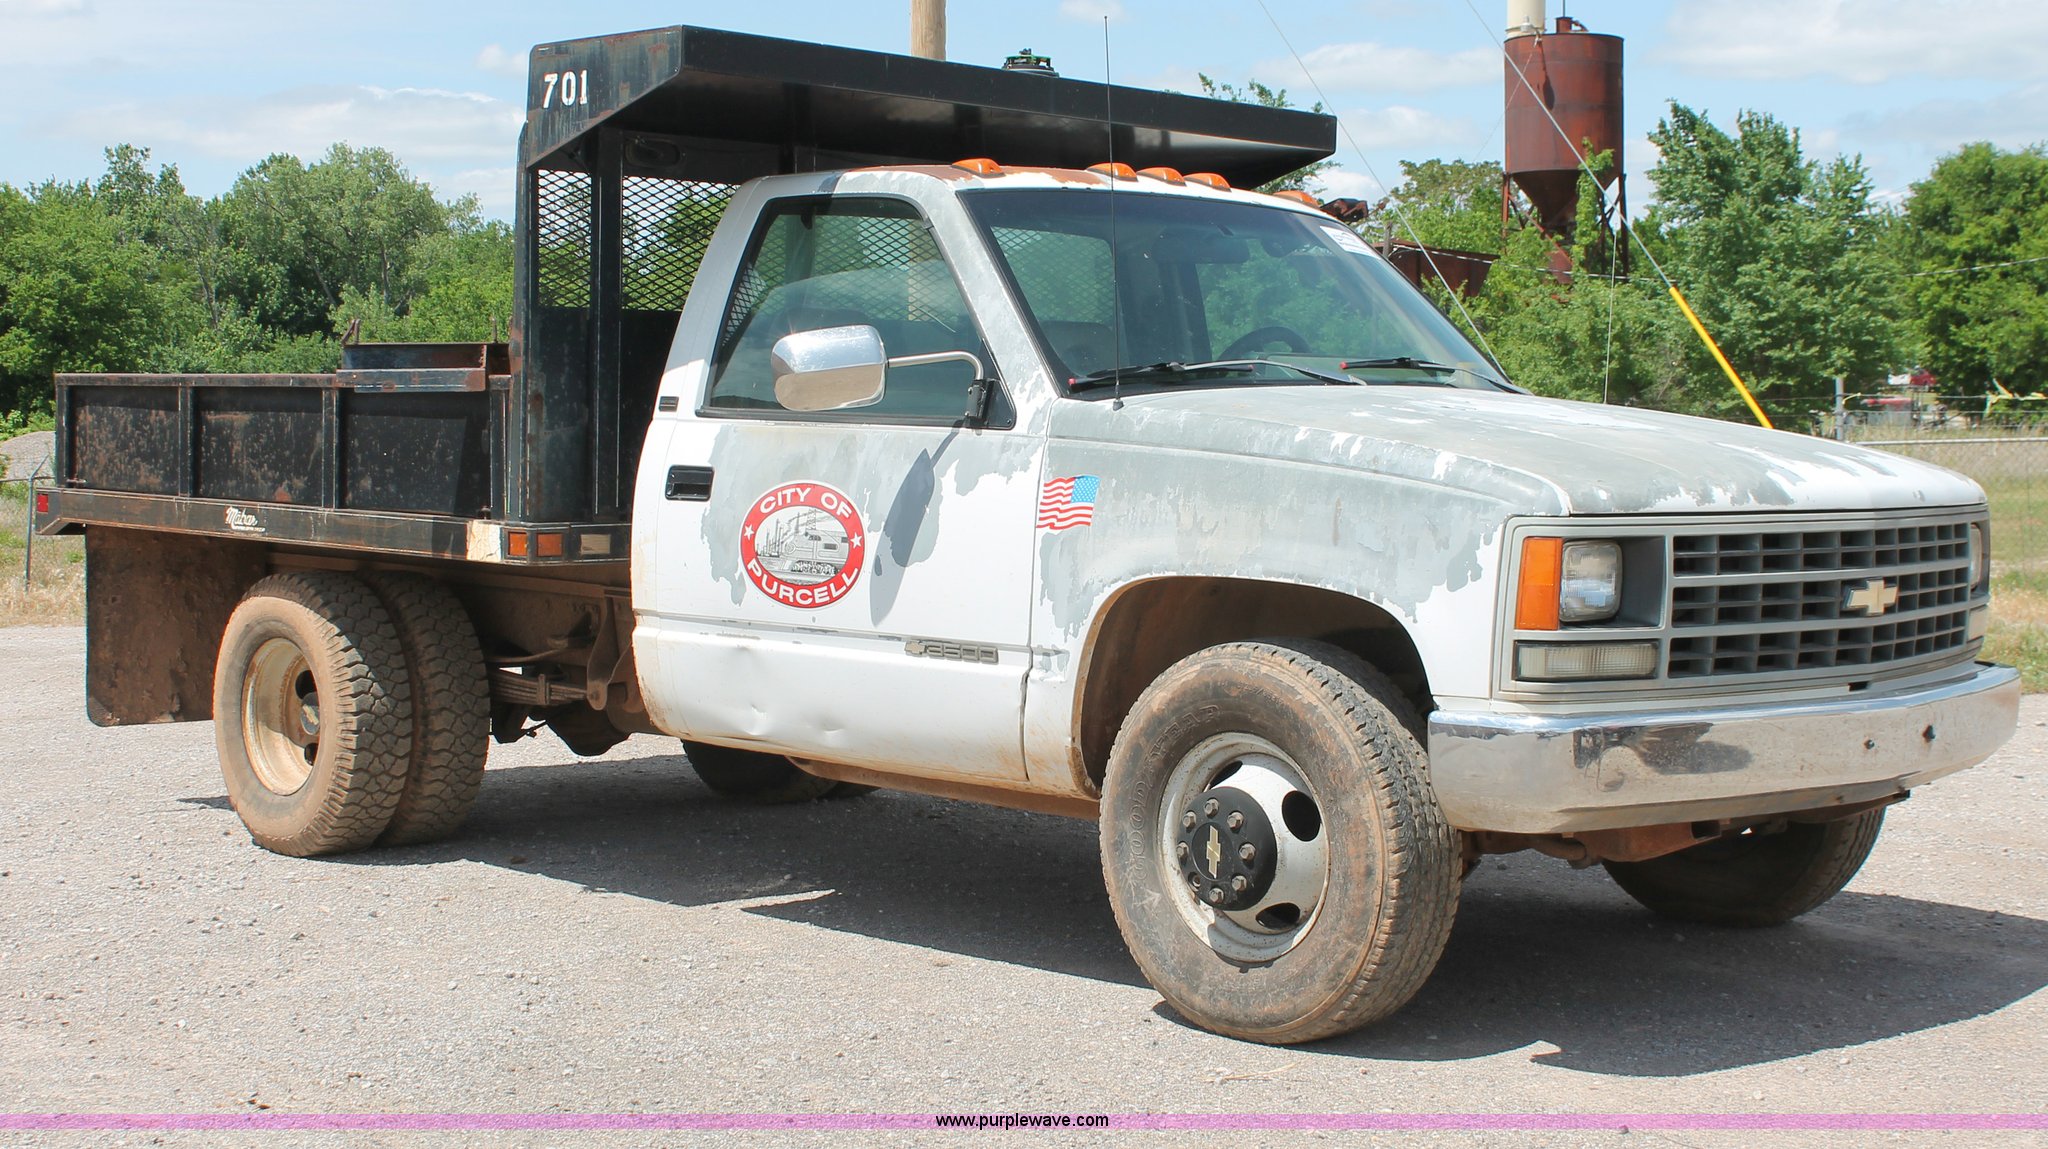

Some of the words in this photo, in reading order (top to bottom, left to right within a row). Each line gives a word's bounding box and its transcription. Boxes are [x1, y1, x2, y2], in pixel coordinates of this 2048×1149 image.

[543, 69, 588, 109] 701
[760, 487, 811, 514] CITY
[820, 492, 852, 518] OF
[747, 558, 859, 605] PURCELL
